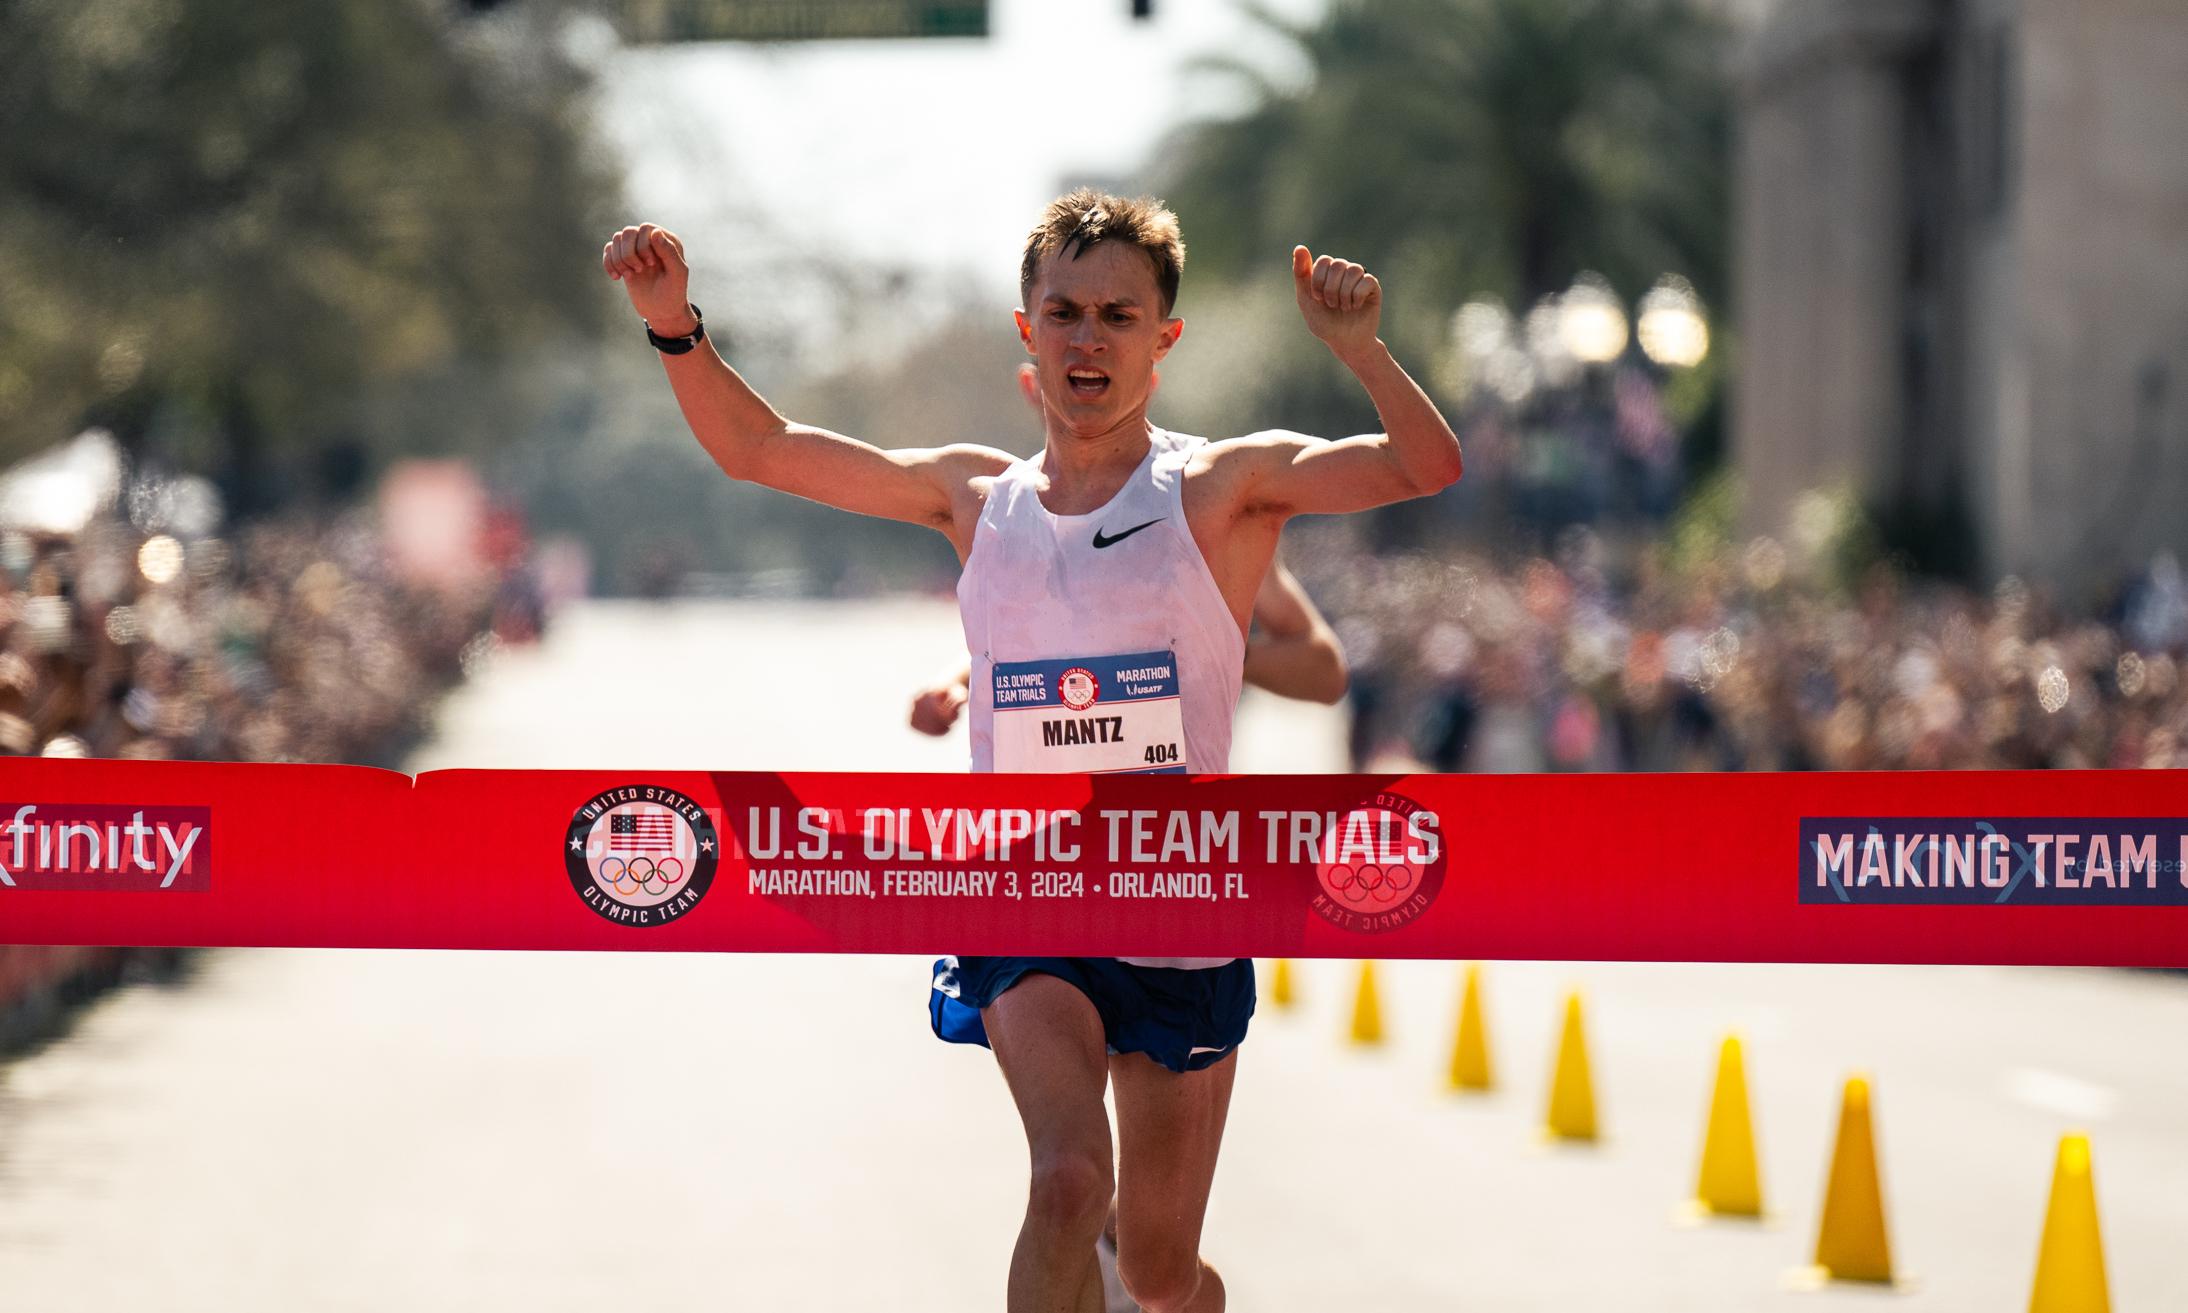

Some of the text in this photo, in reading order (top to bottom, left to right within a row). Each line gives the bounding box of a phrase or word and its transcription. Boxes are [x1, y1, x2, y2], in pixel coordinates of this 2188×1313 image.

[996, 673, 1044, 687] U.S. OLYMPIC
[1116, 665, 1171, 684] MARATHON
[1137, 685, 1163, 694] USATF
[996, 687, 1047, 703] TEAM TRIALS
[1042, 716, 1124, 747] MANTZ
[1144, 743, 1178, 764] 404
[582, 788, 702, 822] UNITED STATES
[749, 806, 842, 860] U.S.
[863, 807, 1081, 862] OLYMPIC
[1100, 809, 1240, 863] TEAM
[1259, 810, 1440, 865] TRIALS
[1817, 833, 2010, 888] MAKING
[2027, 834, 2157, 888] TEAM
[748, 869, 1249, 902] MARATHON, FEBRUARY 3, 2024 ORLANDO, FL
[584, 885, 699, 923] OLYMPIC TEAM
